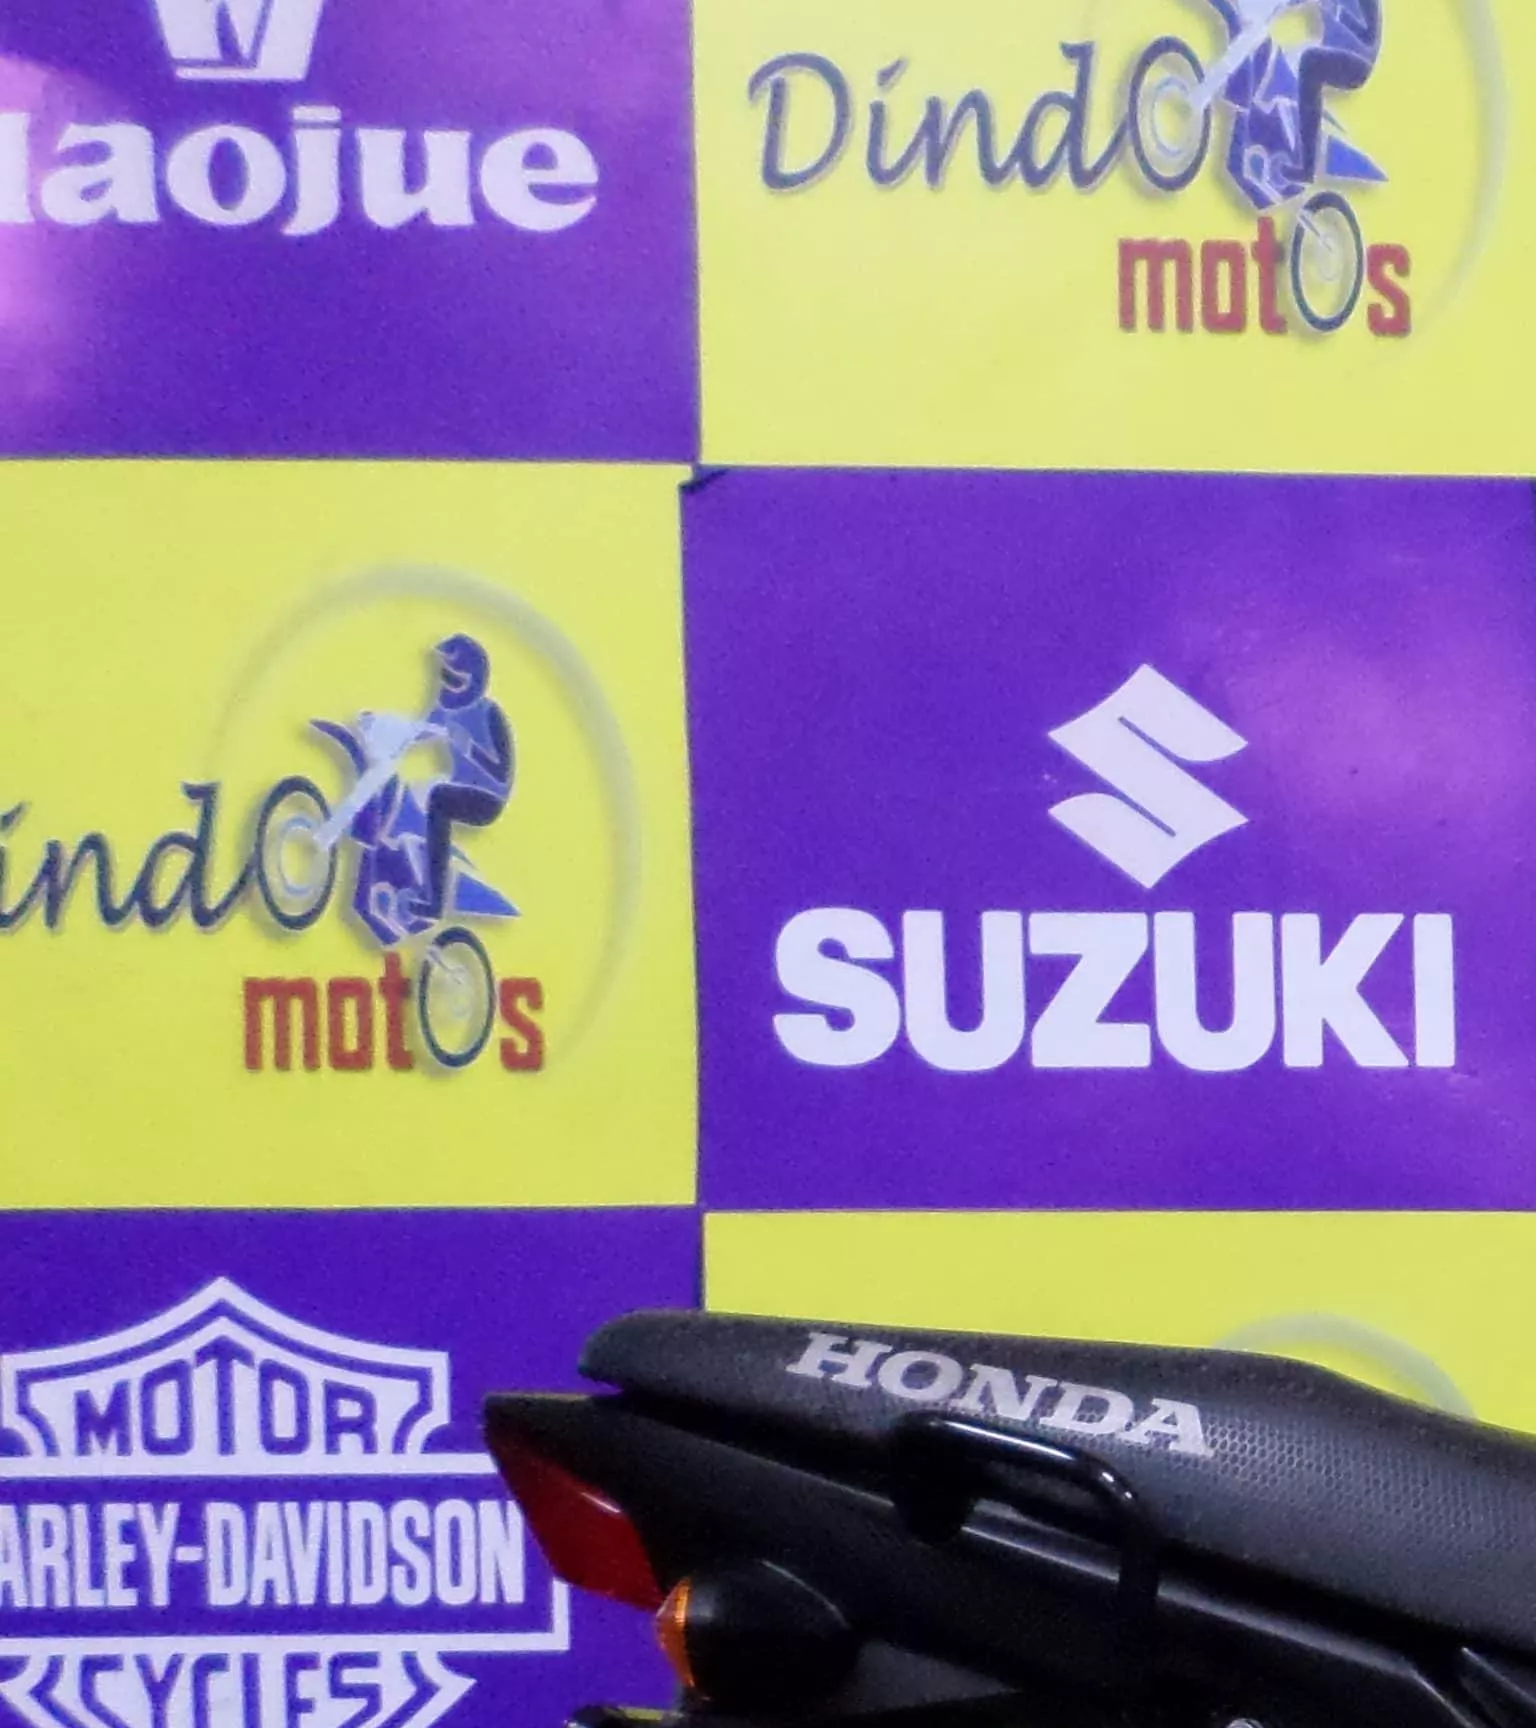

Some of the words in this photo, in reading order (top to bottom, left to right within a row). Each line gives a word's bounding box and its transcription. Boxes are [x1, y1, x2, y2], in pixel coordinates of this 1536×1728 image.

[0, 104, 598, 236] aojue
[772, 907, 1457, 1072] SUZUKI
[73, 1336, 377, 1456] MOTOR
[785, 1331, 1214, 1457] HONDA
[0, 1499, 524, 1609] ARLEY-DAVIDSON
